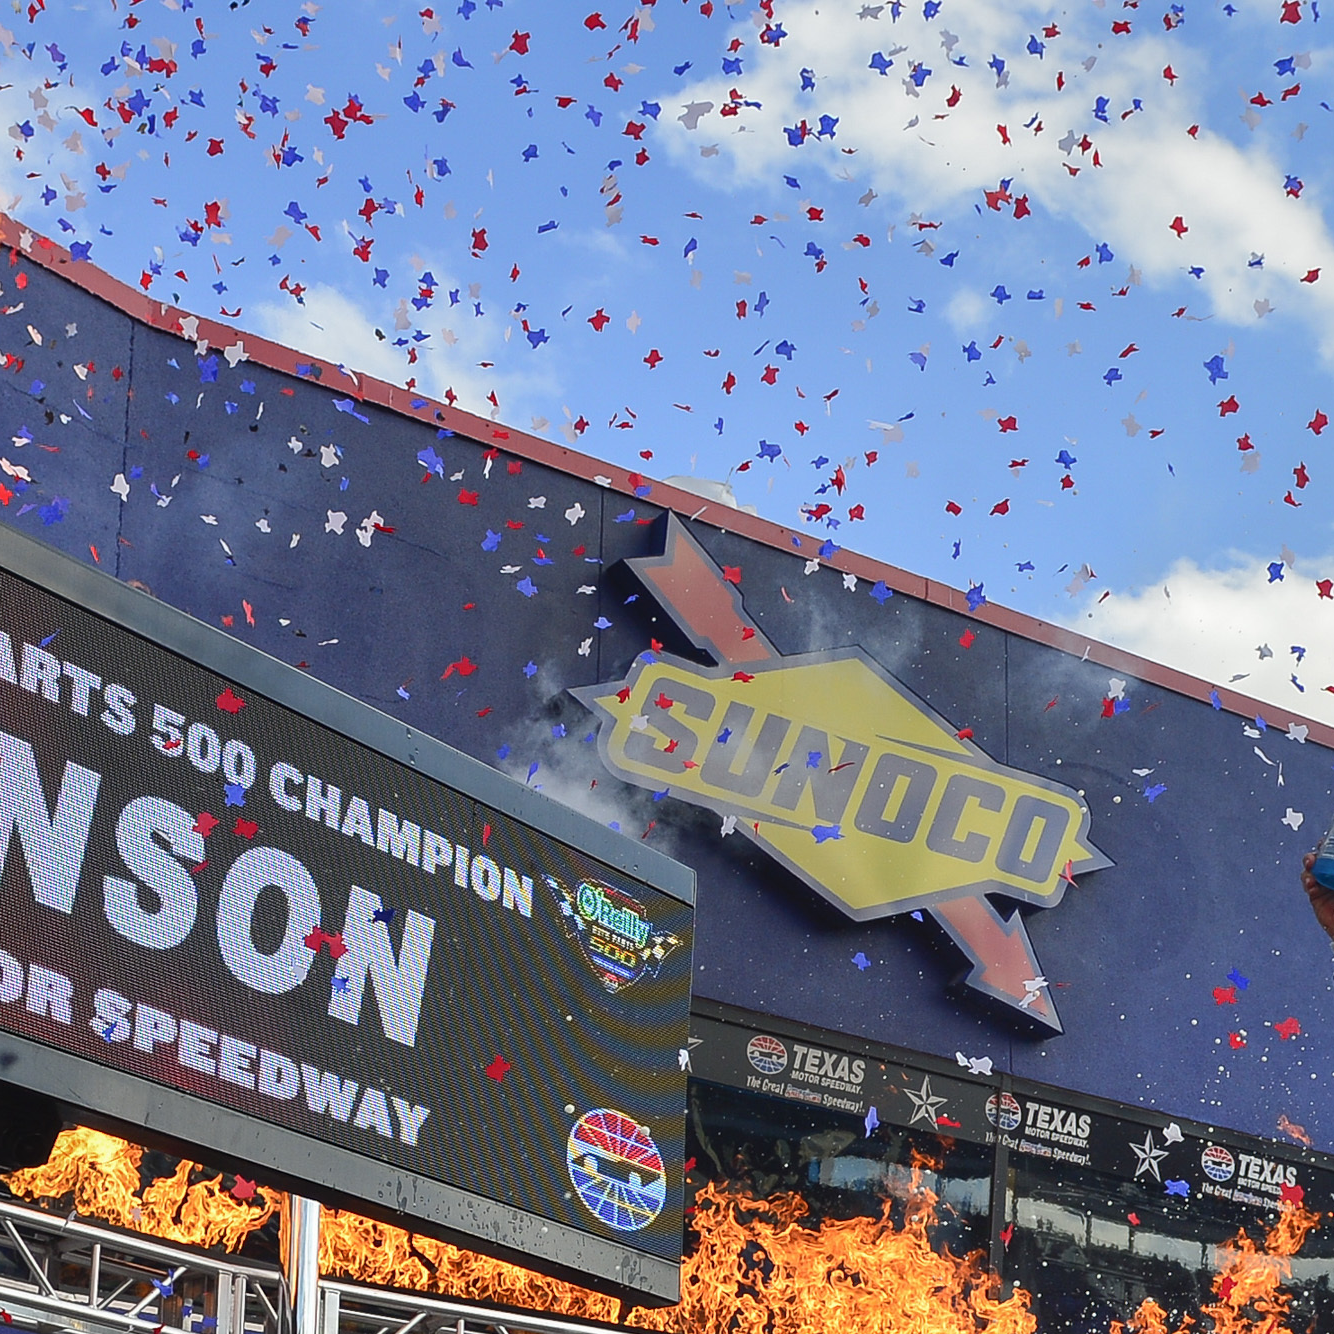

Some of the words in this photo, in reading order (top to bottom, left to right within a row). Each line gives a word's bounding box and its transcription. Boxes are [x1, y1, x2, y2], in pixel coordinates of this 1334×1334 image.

[623, 676, 1072, 884] SUNOCO
[151, 705, 257, 789] 500
[269, 762, 534, 918] CHAMPION
[589, 936, 637, 968] 500
[89, 987, 431, 1147] SPEEDWAY
[792, 1044, 867, 1084] TEXAS
[746, 1074, 763, 1089] The
[763, 1078, 785, 1096] Great
[822, 1093, 865, 1114] Speedway!
[790, 1070, 820, 1085] MOTOR
[821, 1076, 863, 1095] SPEEDWAY
[1025, 1101, 1092, 1139] TEXAS
[1025, 1127, 1050, 1140] MOTOR
[1051, 1132, 1090, 1149] SPEEDWAY
[1052, 1149, 1092, 1167] Speedway!
[1238, 1153, 1298, 1188] TEXAS
[1201, 1181, 1214, 1195] The
